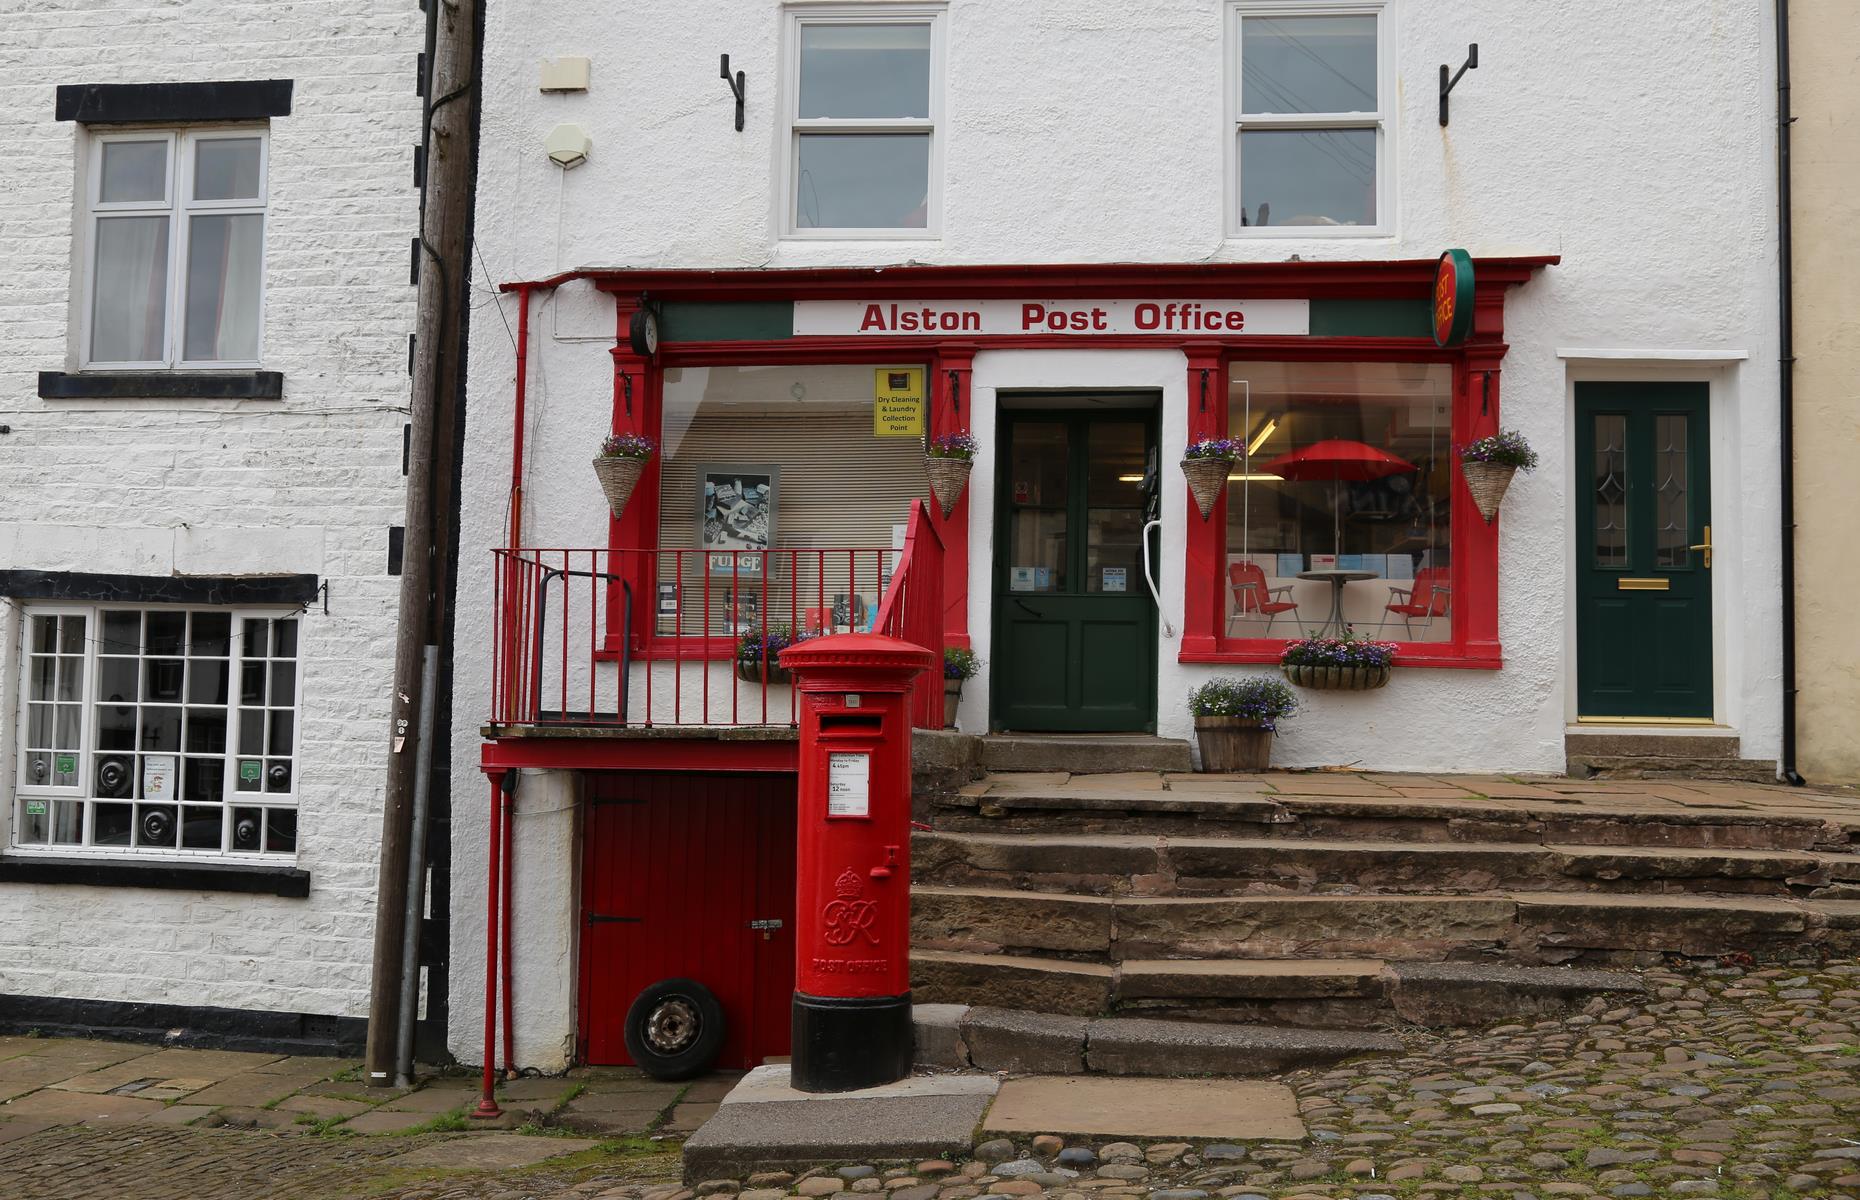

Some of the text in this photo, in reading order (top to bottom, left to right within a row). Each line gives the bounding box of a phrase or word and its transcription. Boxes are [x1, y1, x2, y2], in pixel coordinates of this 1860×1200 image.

[860, 303, 1245, 331] Alston Post Office
[878, 396, 920, 404] Dry Cleaning
[889, 405, 916, 413] Laundry
[708, 554, 761, 571] FUDGE
[813, 958, 888, 972] POST OFFICE
